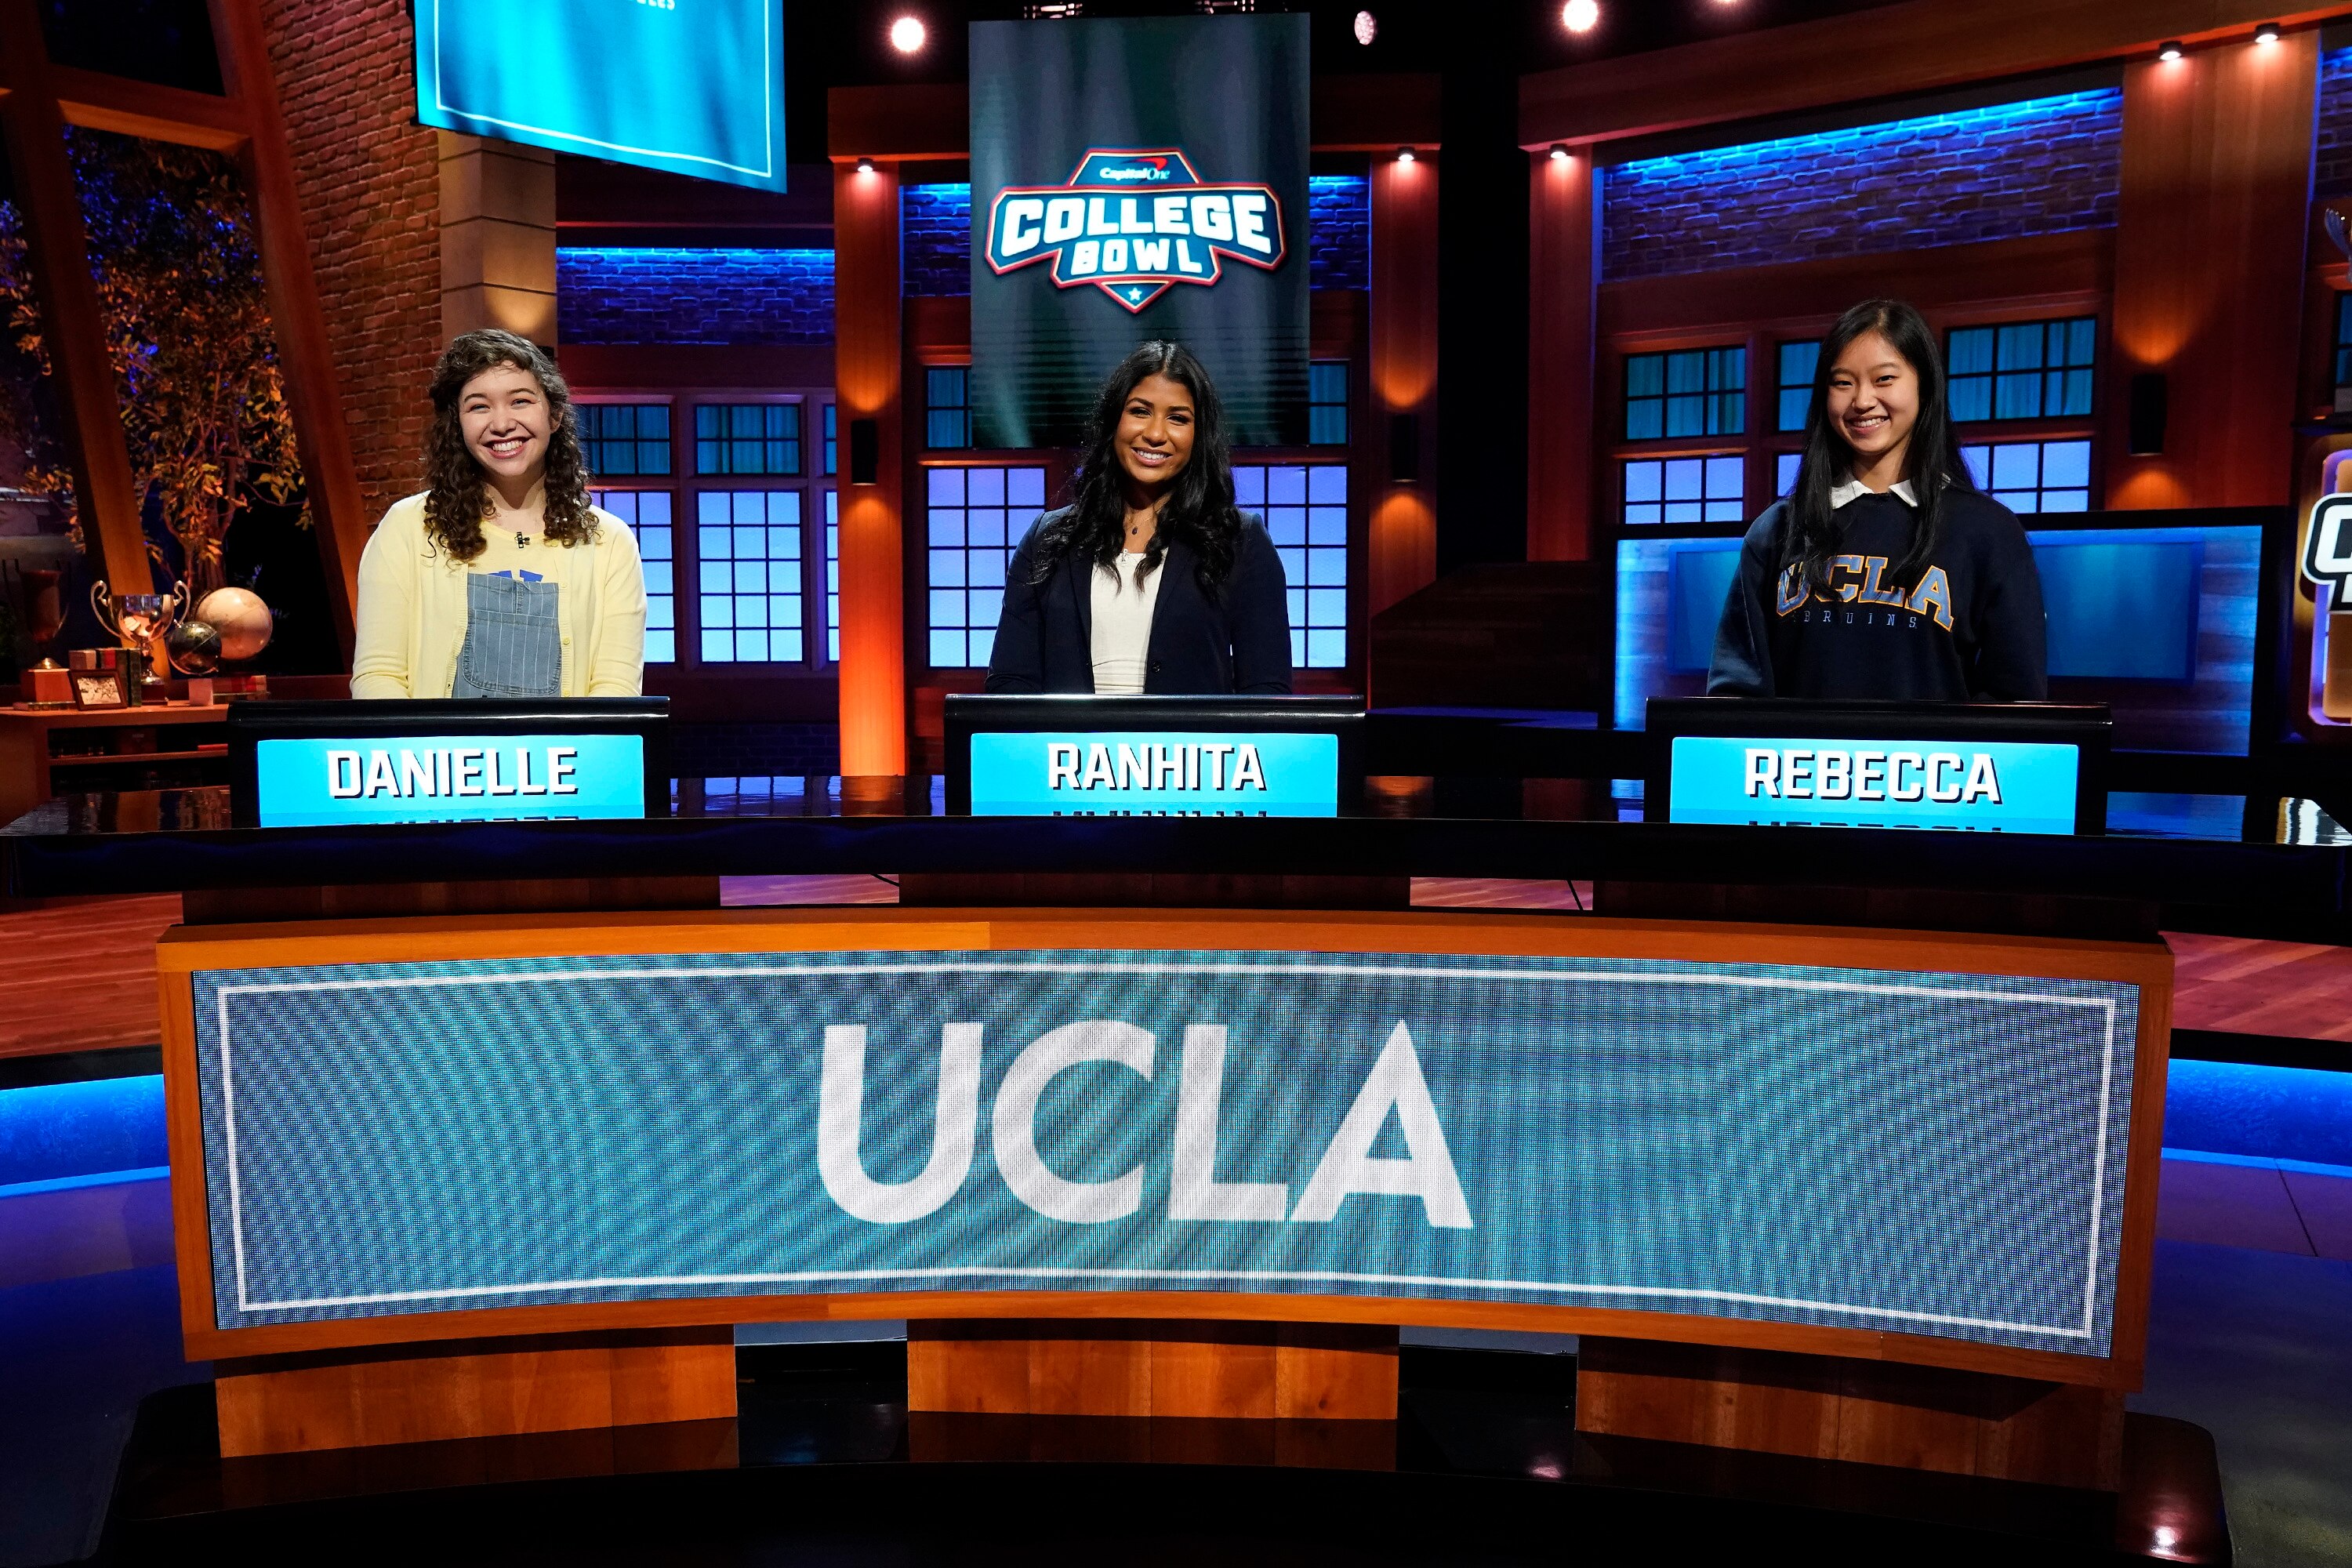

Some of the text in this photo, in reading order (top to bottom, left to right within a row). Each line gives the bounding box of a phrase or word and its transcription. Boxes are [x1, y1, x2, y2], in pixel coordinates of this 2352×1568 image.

[1001, 195, 1271, 256] COLLEGE
[1070, 238, 1202, 275] BOWL
[1777, 554, 1954, 632] UCLA
[1804, 611, 1917, 628] BRUINS
[327, 746, 578, 799] DANIELLE
[1047, 742, 1267, 790] RANHITA
[1744, 748, 2002, 804] REBECCA
[817, 1019, 1474, 1229] UCLA
